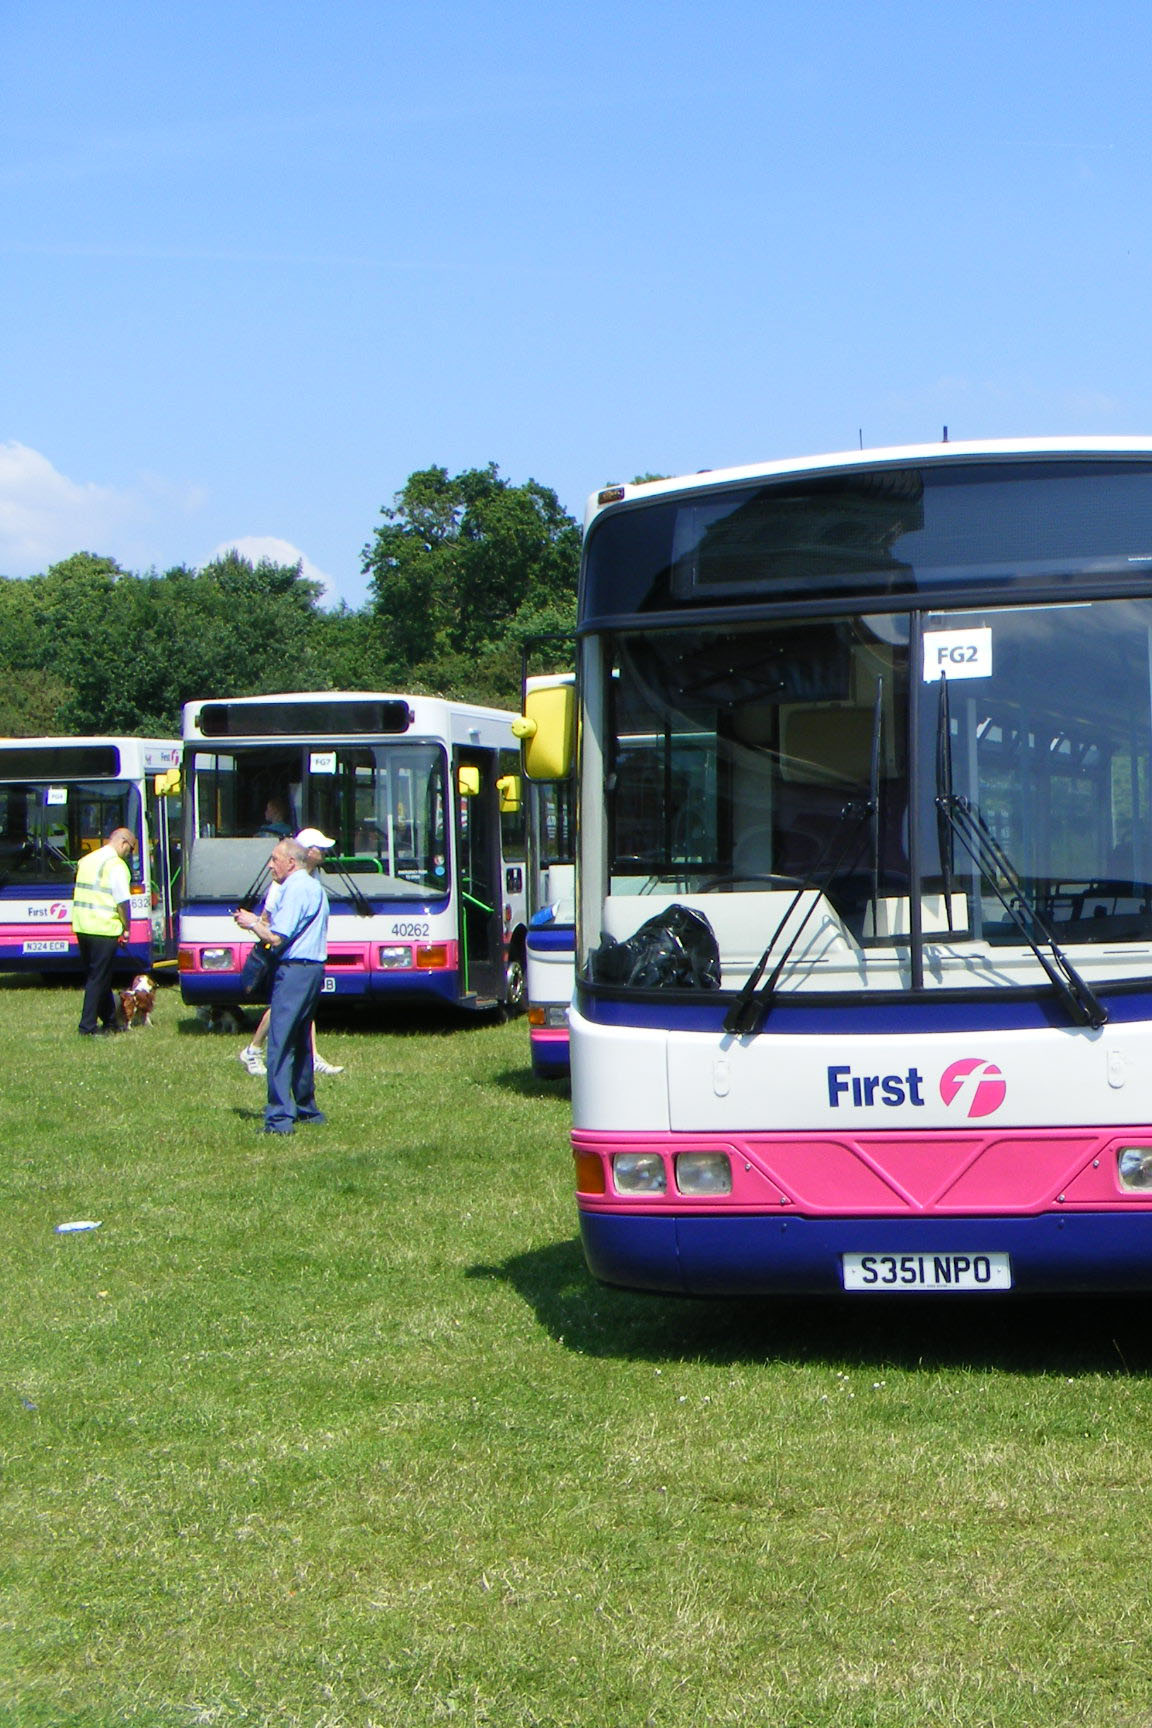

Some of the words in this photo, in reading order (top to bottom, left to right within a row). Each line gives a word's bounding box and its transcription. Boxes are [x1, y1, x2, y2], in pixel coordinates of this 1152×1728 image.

[937, 645, 978, 665] FG2
[28, 907, 48, 917] First
[391, 923, 430, 937] 40262
[26, 941, 48, 951] N324
[49, 941, 65, 950] ECR
[827, 1065, 925, 1108] First
[861, 1256, 925, 1284] S351
[933, 1256, 991, 1284] NPO
